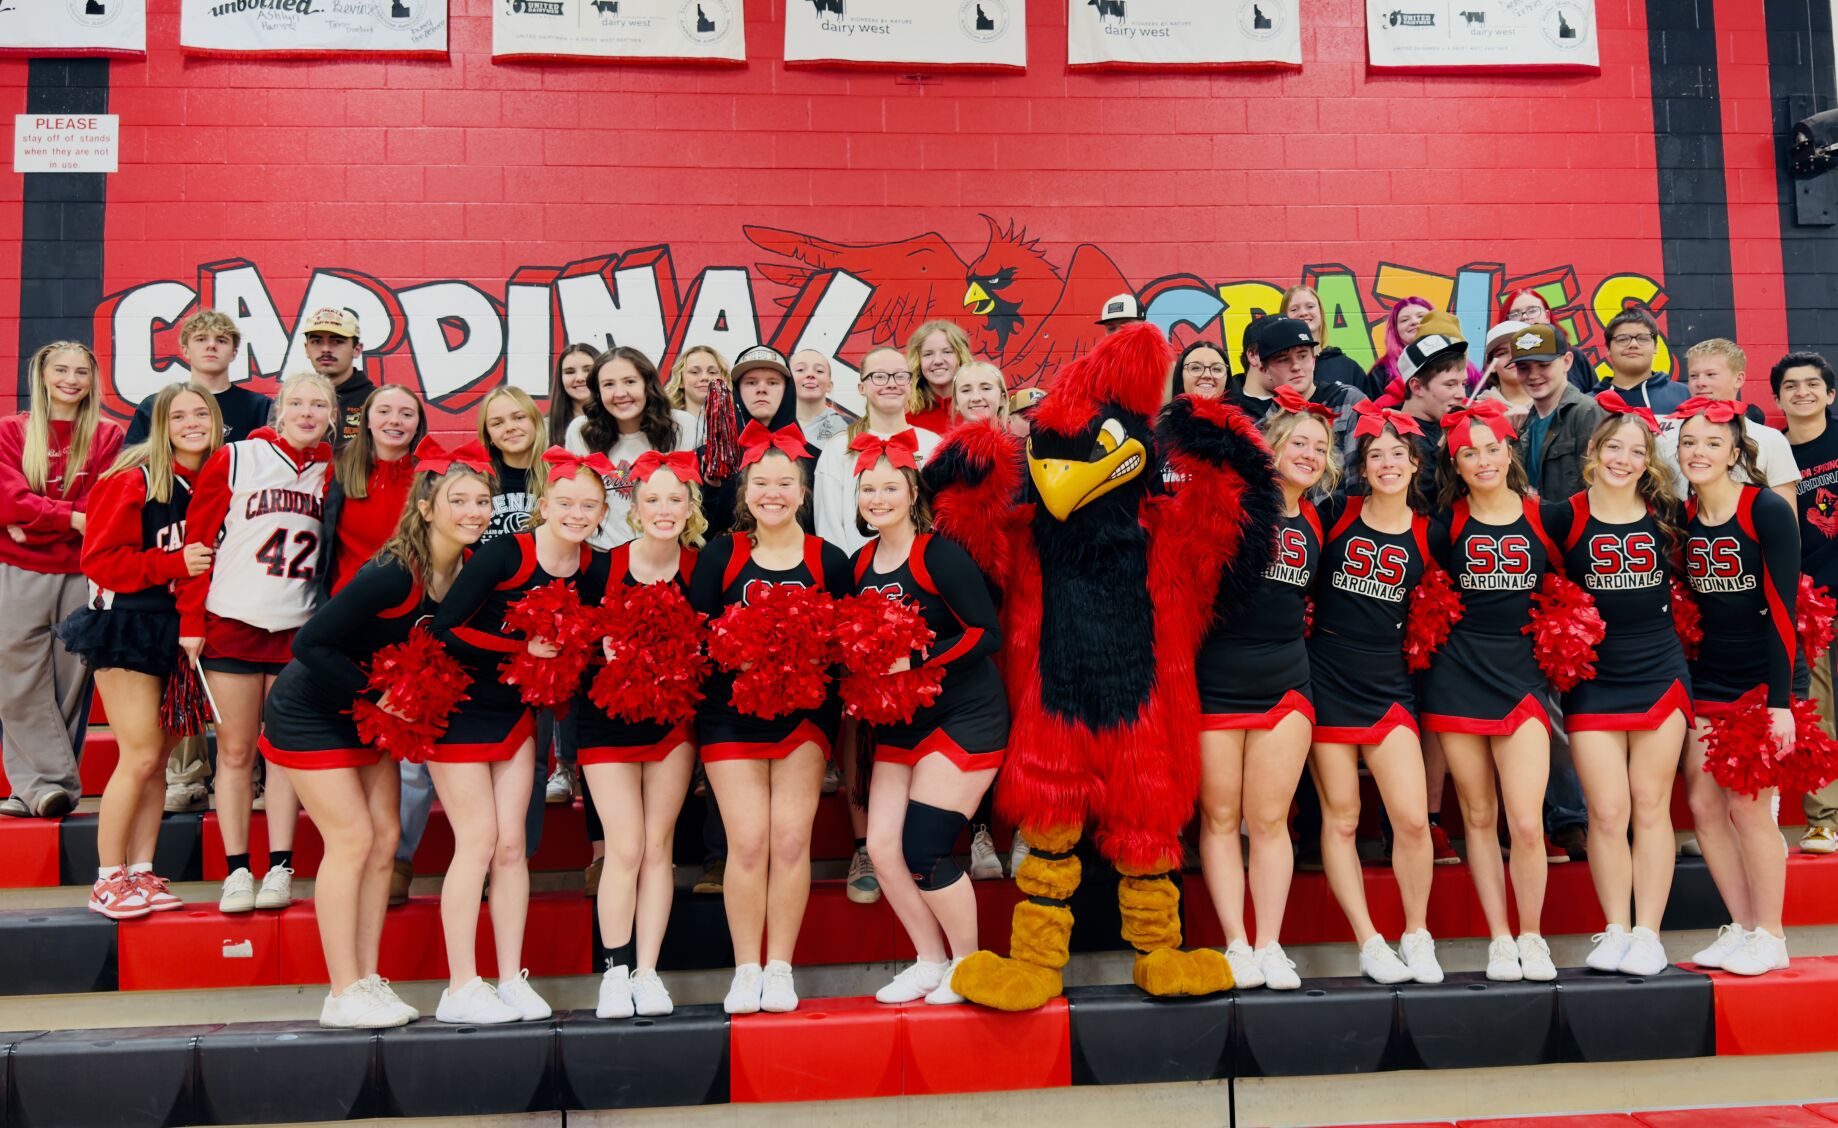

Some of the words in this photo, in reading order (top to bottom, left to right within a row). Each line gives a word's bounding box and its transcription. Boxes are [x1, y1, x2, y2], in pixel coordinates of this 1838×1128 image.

[601, 18, 627, 28] dairy
[628, 19, 651, 27] west
[821, 19, 855, 36] dairy
[858, 24, 891, 35] west
[1104, 24, 1136, 39] dairy
[1139, 27, 1171, 37] west
[36, 118, 98, 130] PLEASE
[22, 134, 42, 143] stay
[47, 134, 60, 143] off
[64, 134, 75, 143] of
[79, 134, 111, 143] stands
[24, 147, 48, 156] when
[52, 147, 72, 157] they
[75, 148, 90, 156] are
[94, 147, 109, 156] not
[49, 161, 57, 169] in
[61, 161, 81, 169] use.
[98, 244, 874, 416] CARDINAL
[256, 527, 318, 580] 42
[1342, 536, 1409, 586] SS
[1465, 535, 1531, 575] SS
[1589, 532, 1657, 575] SS
[1687, 536, 1743, 578] SS
[1332, 571, 1406, 602] CARDINALS
[1459, 573, 1537, 591] CARDINALS
[1584, 570, 1664, 590] CARDINALS
